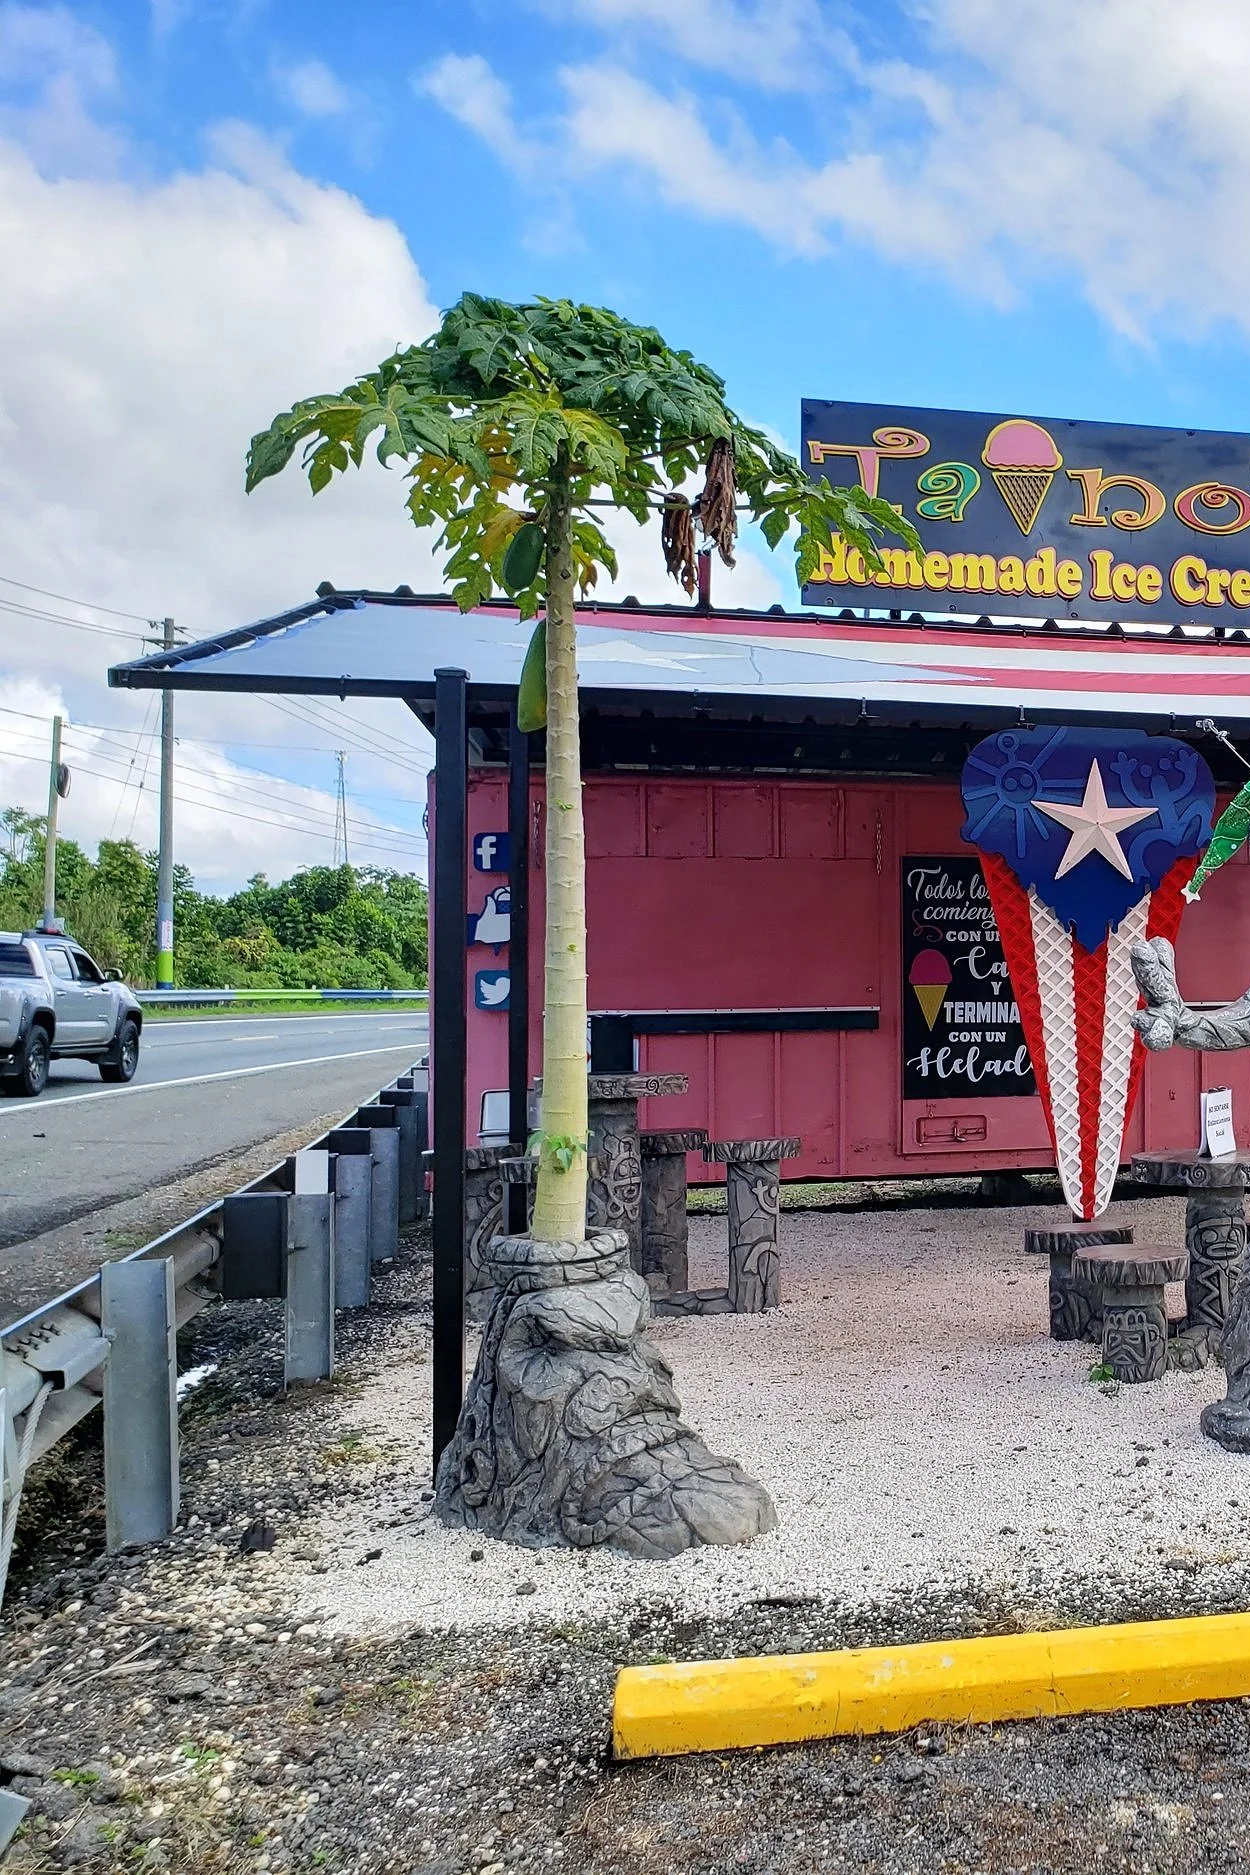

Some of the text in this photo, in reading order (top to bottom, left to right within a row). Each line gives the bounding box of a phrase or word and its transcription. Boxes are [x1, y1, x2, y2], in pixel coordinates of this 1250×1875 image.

[808, 531, 1083, 599] Homemade
[1089, 549, 1162, 603] Ice
[907, 866, 991, 901] Todos lo
[946, 931, 981, 942] CON
[990, 981, 1002, 996] Y
[943, 1001, 1021, 1024] TERMINA
[948, 1031, 1006, 1043] CON UN
